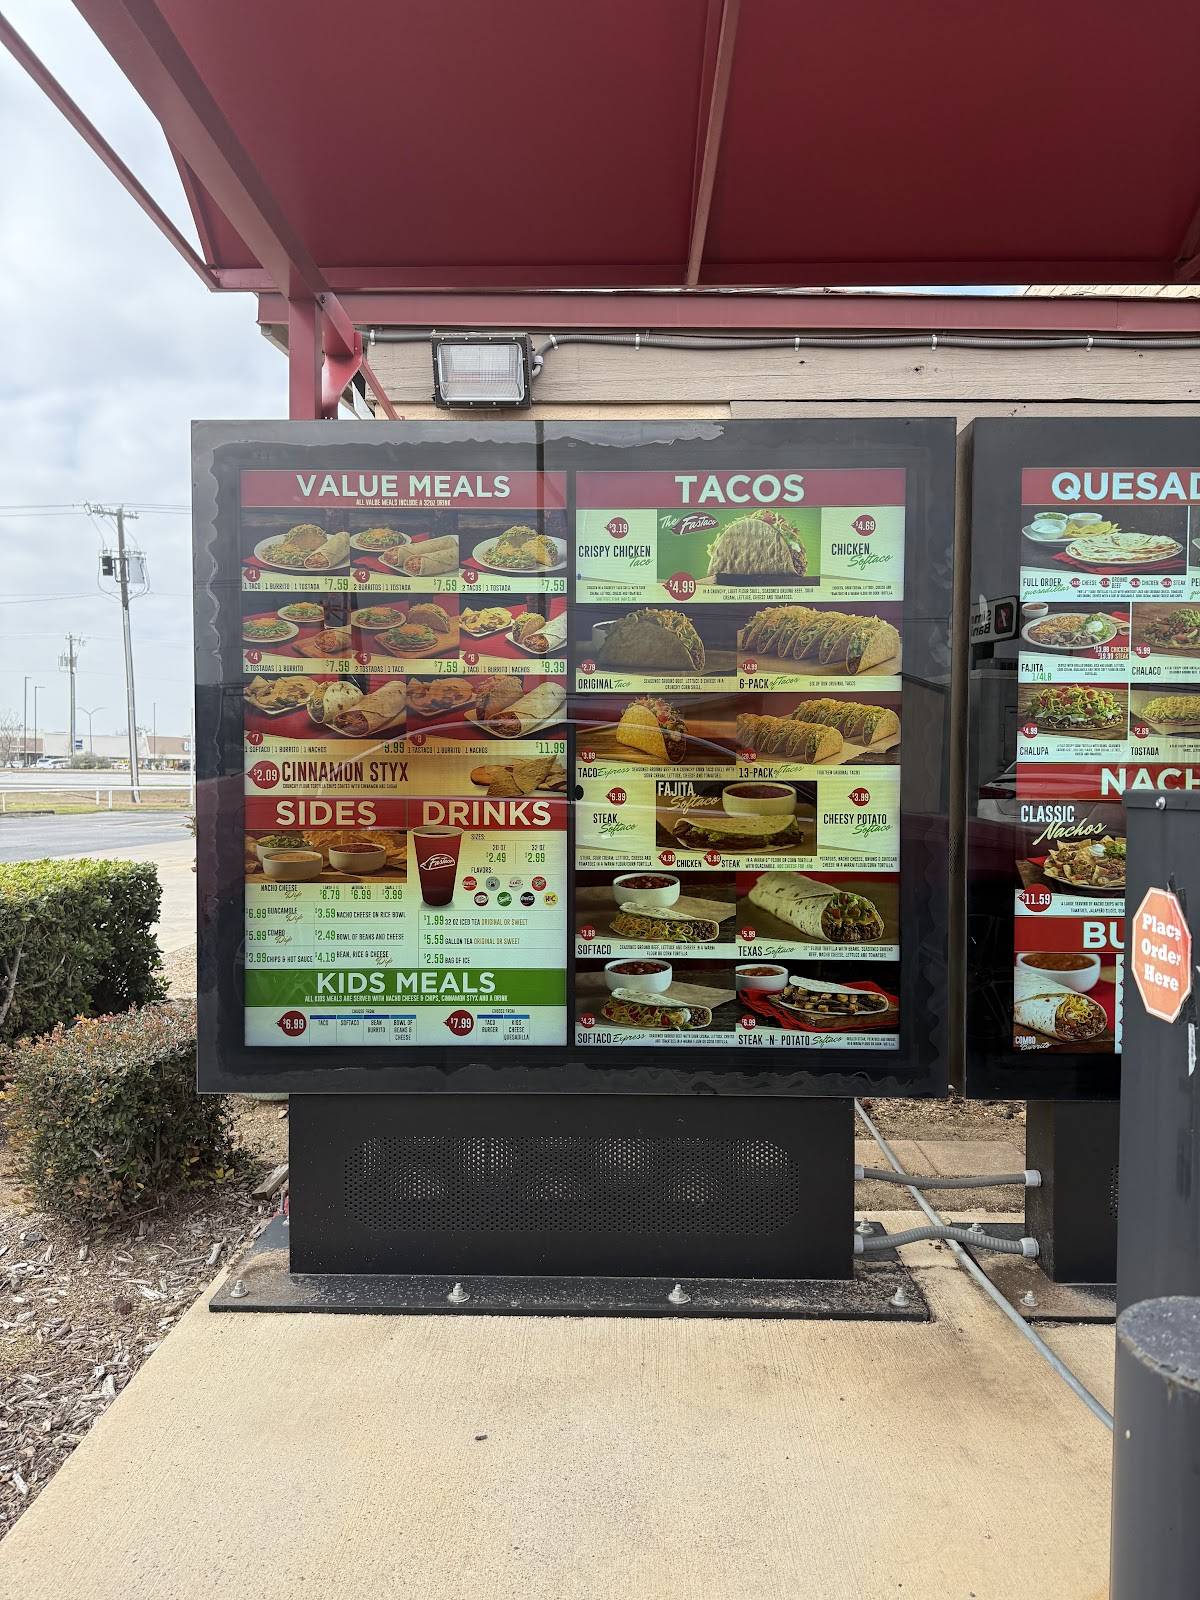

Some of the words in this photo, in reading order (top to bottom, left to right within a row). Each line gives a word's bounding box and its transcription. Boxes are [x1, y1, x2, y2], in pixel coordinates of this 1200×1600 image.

[296, 475, 398, 497] VALUE
[409, 475, 511, 498] MEALS
[675, 475, 805, 502] TACOS
[610, 523, 628, 533] $3.19
[659, 515, 680, 529] The
[856, 520, 875, 531] $4.69
[578, 545, 610, 557] CRISPY
[613, 545, 651, 557] CHICKEN
[831, 543, 870, 555] CHICKEN
[629, 556, 652, 568] Taco
[848, 553, 893, 570] Softaco
[325, 578, 349, 591] $7.59
[433, 579, 457, 592] $7.59
[541, 579, 565, 591] $7.59
[669, 580, 695, 593] $4.99
[1023, 577, 1038, 587] FULL
[1040, 577, 1062, 587] ORDER
[326, 660, 350, 673] $7.59
[434, 661, 458, 673] $7.59
[1021, 664, 1044, 673] FAJITA
[1131, 666, 1162, 676] CHALACO
[578, 679, 614, 689] ORIGINAL
[613, 680, 632, 689] Taco
[739, 678, 769, 689] 6-PACK
[1020, 747, 1049, 756] CHALUPA
[1131, 747, 1159, 756] TOSTADA
[253, 769, 277, 781] $2.09
[282, 762, 364, 782] CINNAMON
[369, 761, 408, 782] STYX
[578, 767, 598, 778] TACO
[597, 768, 630, 779] Express
[739, 767, 774, 778] 13-PACK
[658, 782, 695, 797] FAJITA
[610, 792, 626, 801] $6.99
[666, 796, 722, 815] Softaco
[276, 800, 377, 826] SIDES
[423, 801, 551, 826] DRINKS
[593, 813, 618, 823] STEAK
[823, 813, 854, 825] CHEESY
[857, 813, 887, 825] POTATO
[1020, 805, 1075, 823] CLASSIC
[598, 822, 637, 838] Softaco
[852, 823, 893, 838] Softaco
[1032, 818, 1106, 846] Nachos
[486, 852, 507, 863] $2.49
[525, 852, 545, 863] $2.99
[676, 859, 702, 868] CHICKEN
[721, 860, 741, 868] STEAK
[320, 889, 340, 900] $8.79
[351, 889, 372, 900] $6.99
[382, 889, 403, 900] $3.99
[315, 908, 336, 918] $3.59
[424, 915, 444, 926] $1.99
[315, 930, 336, 940] $2.49
[424, 934, 444, 945] $5.59
[1083, 921, 1124, 949] BU
[577, 944, 611, 955] SOFTACO
[738, 946, 763, 957] TEXAS
[763, 945, 796, 958] Softaco
[1141, 938, 1181, 966] Order
[315, 952, 336, 962] $4.19
[424, 954, 444, 964] $2.59
[317, 972, 386, 994] KIDS
[396, 973, 496, 993] MEALS
[1143, 964, 1179, 992] Here
[282, 1018, 304, 1030] $6.99
[451, 1018, 472, 1029] $7.99
[577, 1033, 611, 1044] SOFTACO
[612, 1033, 646, 1045] Express
[738, 1035, 763, 1045] STEAK
[781, 1035, 810, 1046] POTATO
[811, 1034, 842, 1048] Softaco
